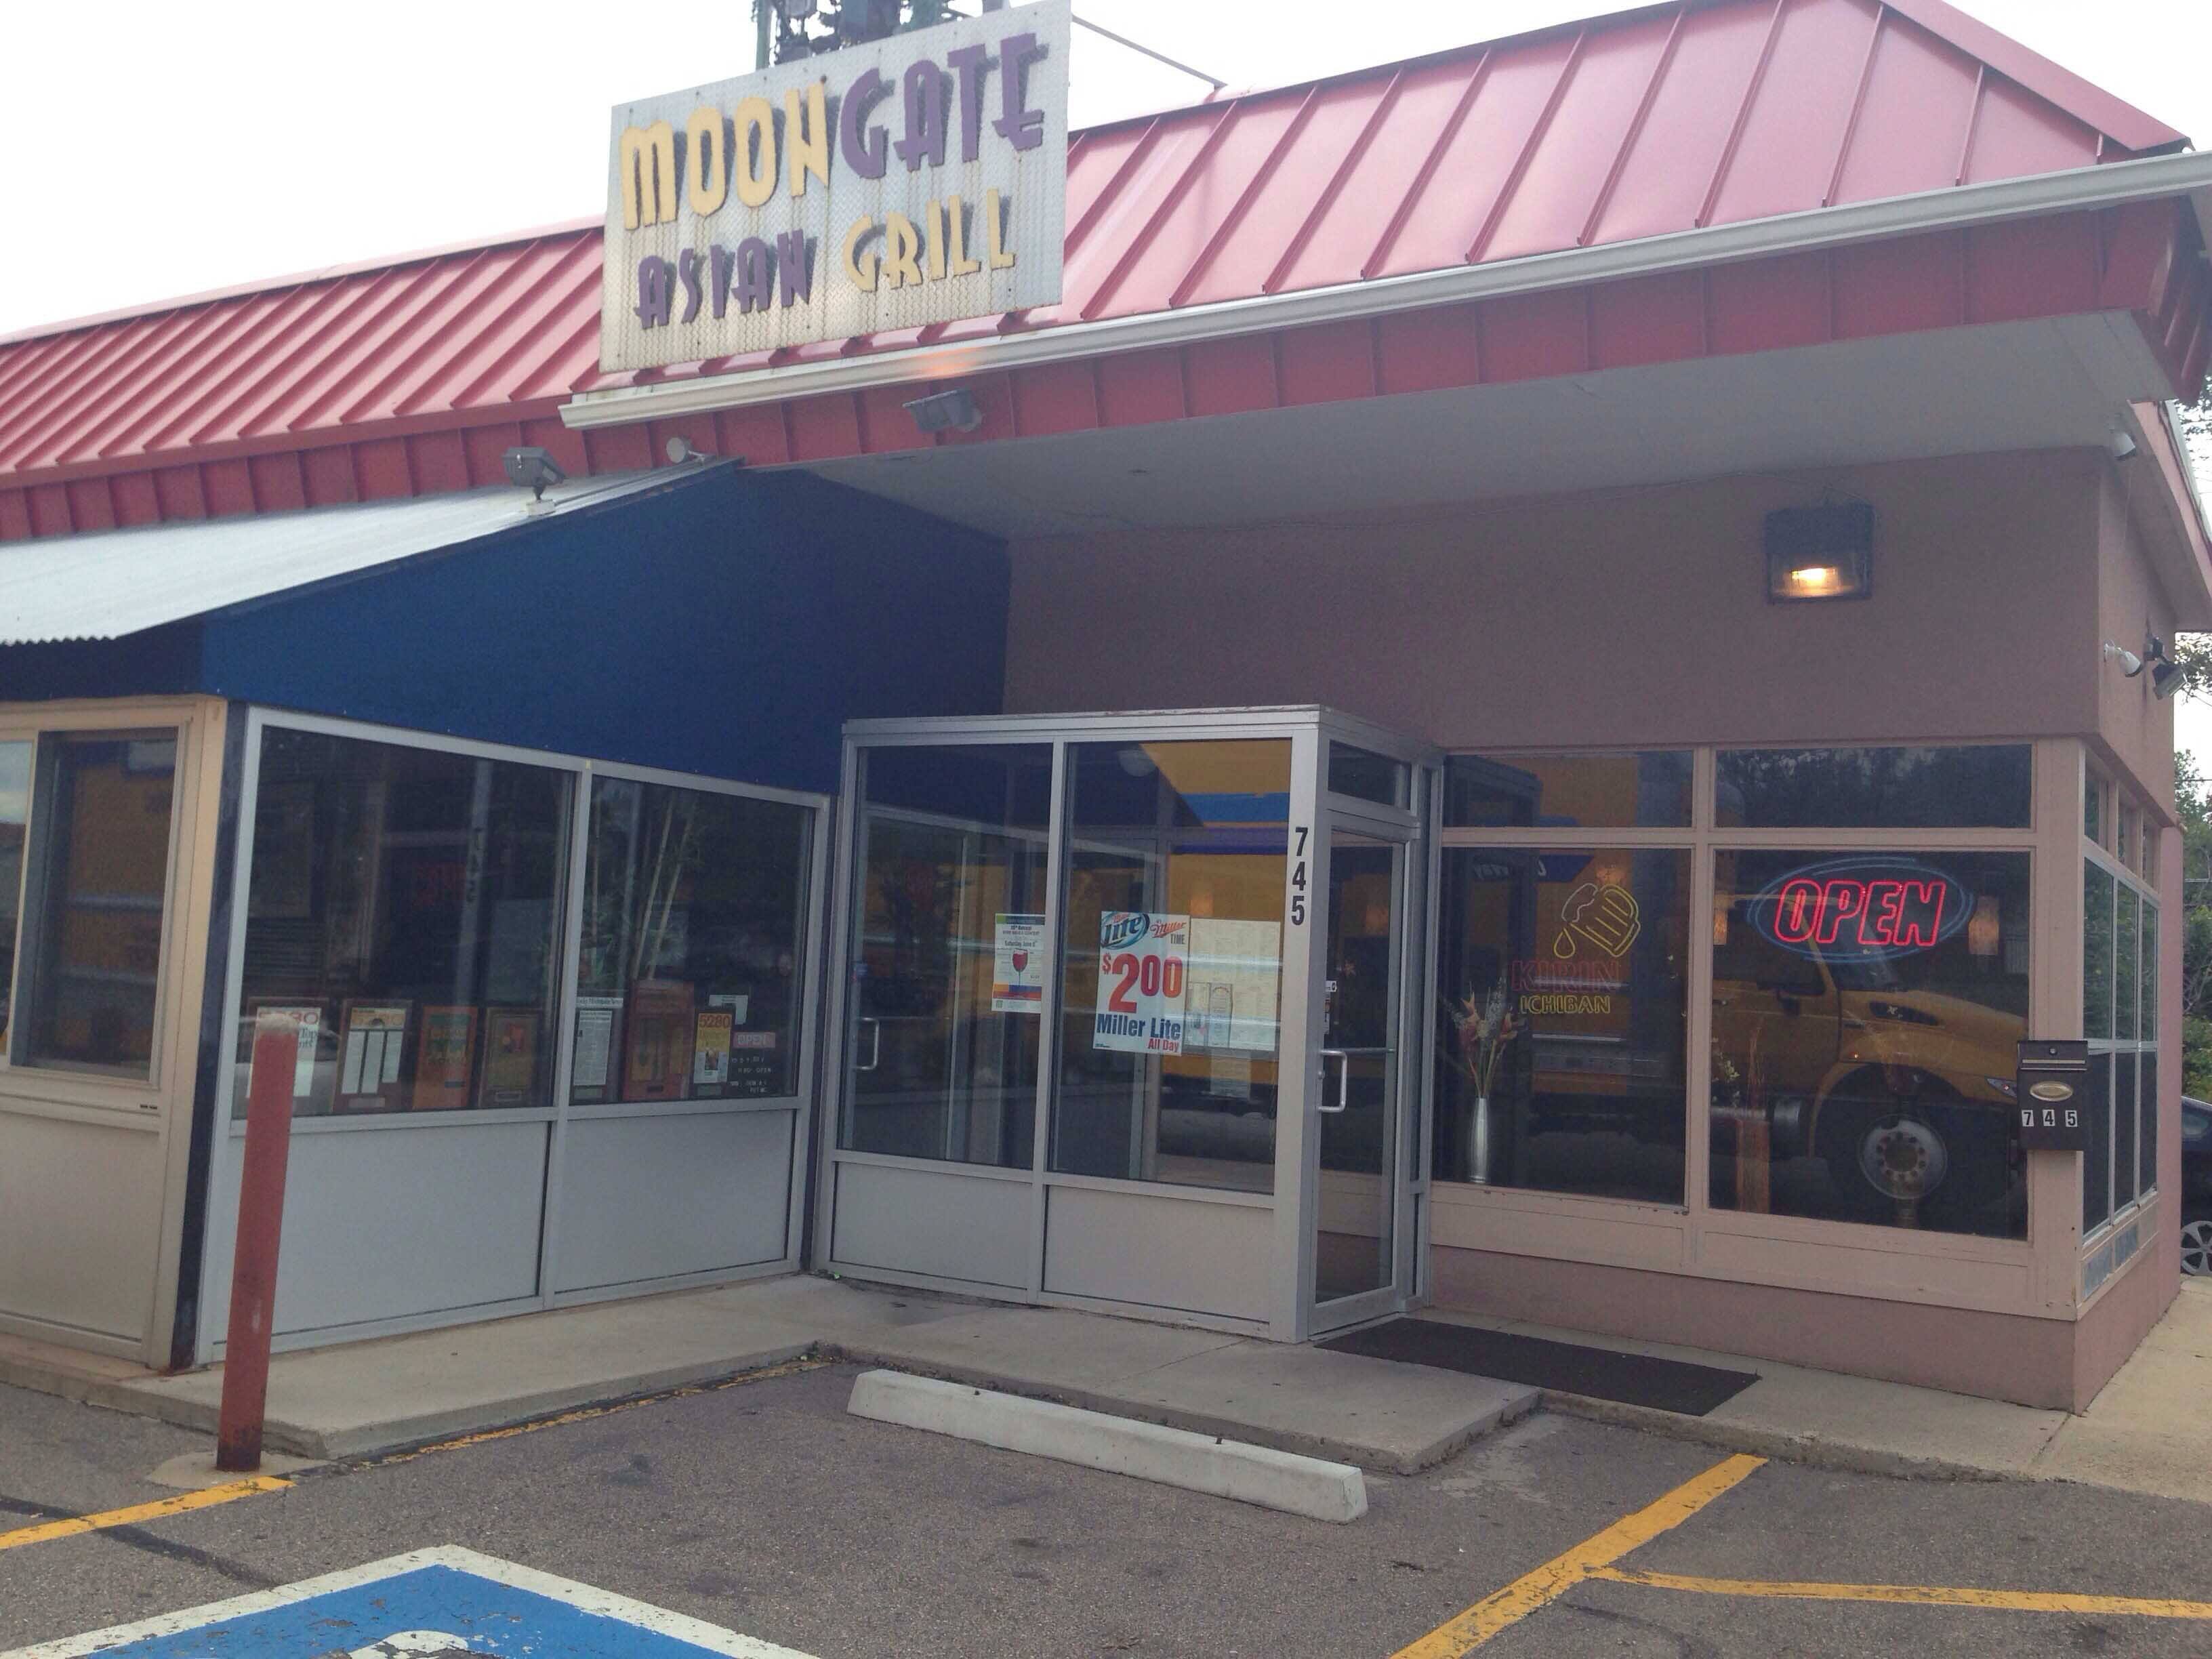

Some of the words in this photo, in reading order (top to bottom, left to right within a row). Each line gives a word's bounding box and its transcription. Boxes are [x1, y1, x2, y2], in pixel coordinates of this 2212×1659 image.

[634, 228, 815, 329] ASIAN
[843, 188, 1015, 292] GRILL
[1774, 878, 1946, 947] OPEN
[1149, 921, 1187, 938] Miller
[1170, 933, 1186, 944] TIME
[1511, 960, 1620, 993] KIRIN
[1519, 994, 1611, 1015] ICHIBAN
[699, 1014, 730, 1028] 5280
[1096, 1013, 1146, 1037] Miller
[1150, 1017, 1181, 1040] Lite
[737, 1034, 767, 1046] OPEN
[1148, 1038, 1160, 1050] All
[1162, 1039, 1179, 1052] Day
